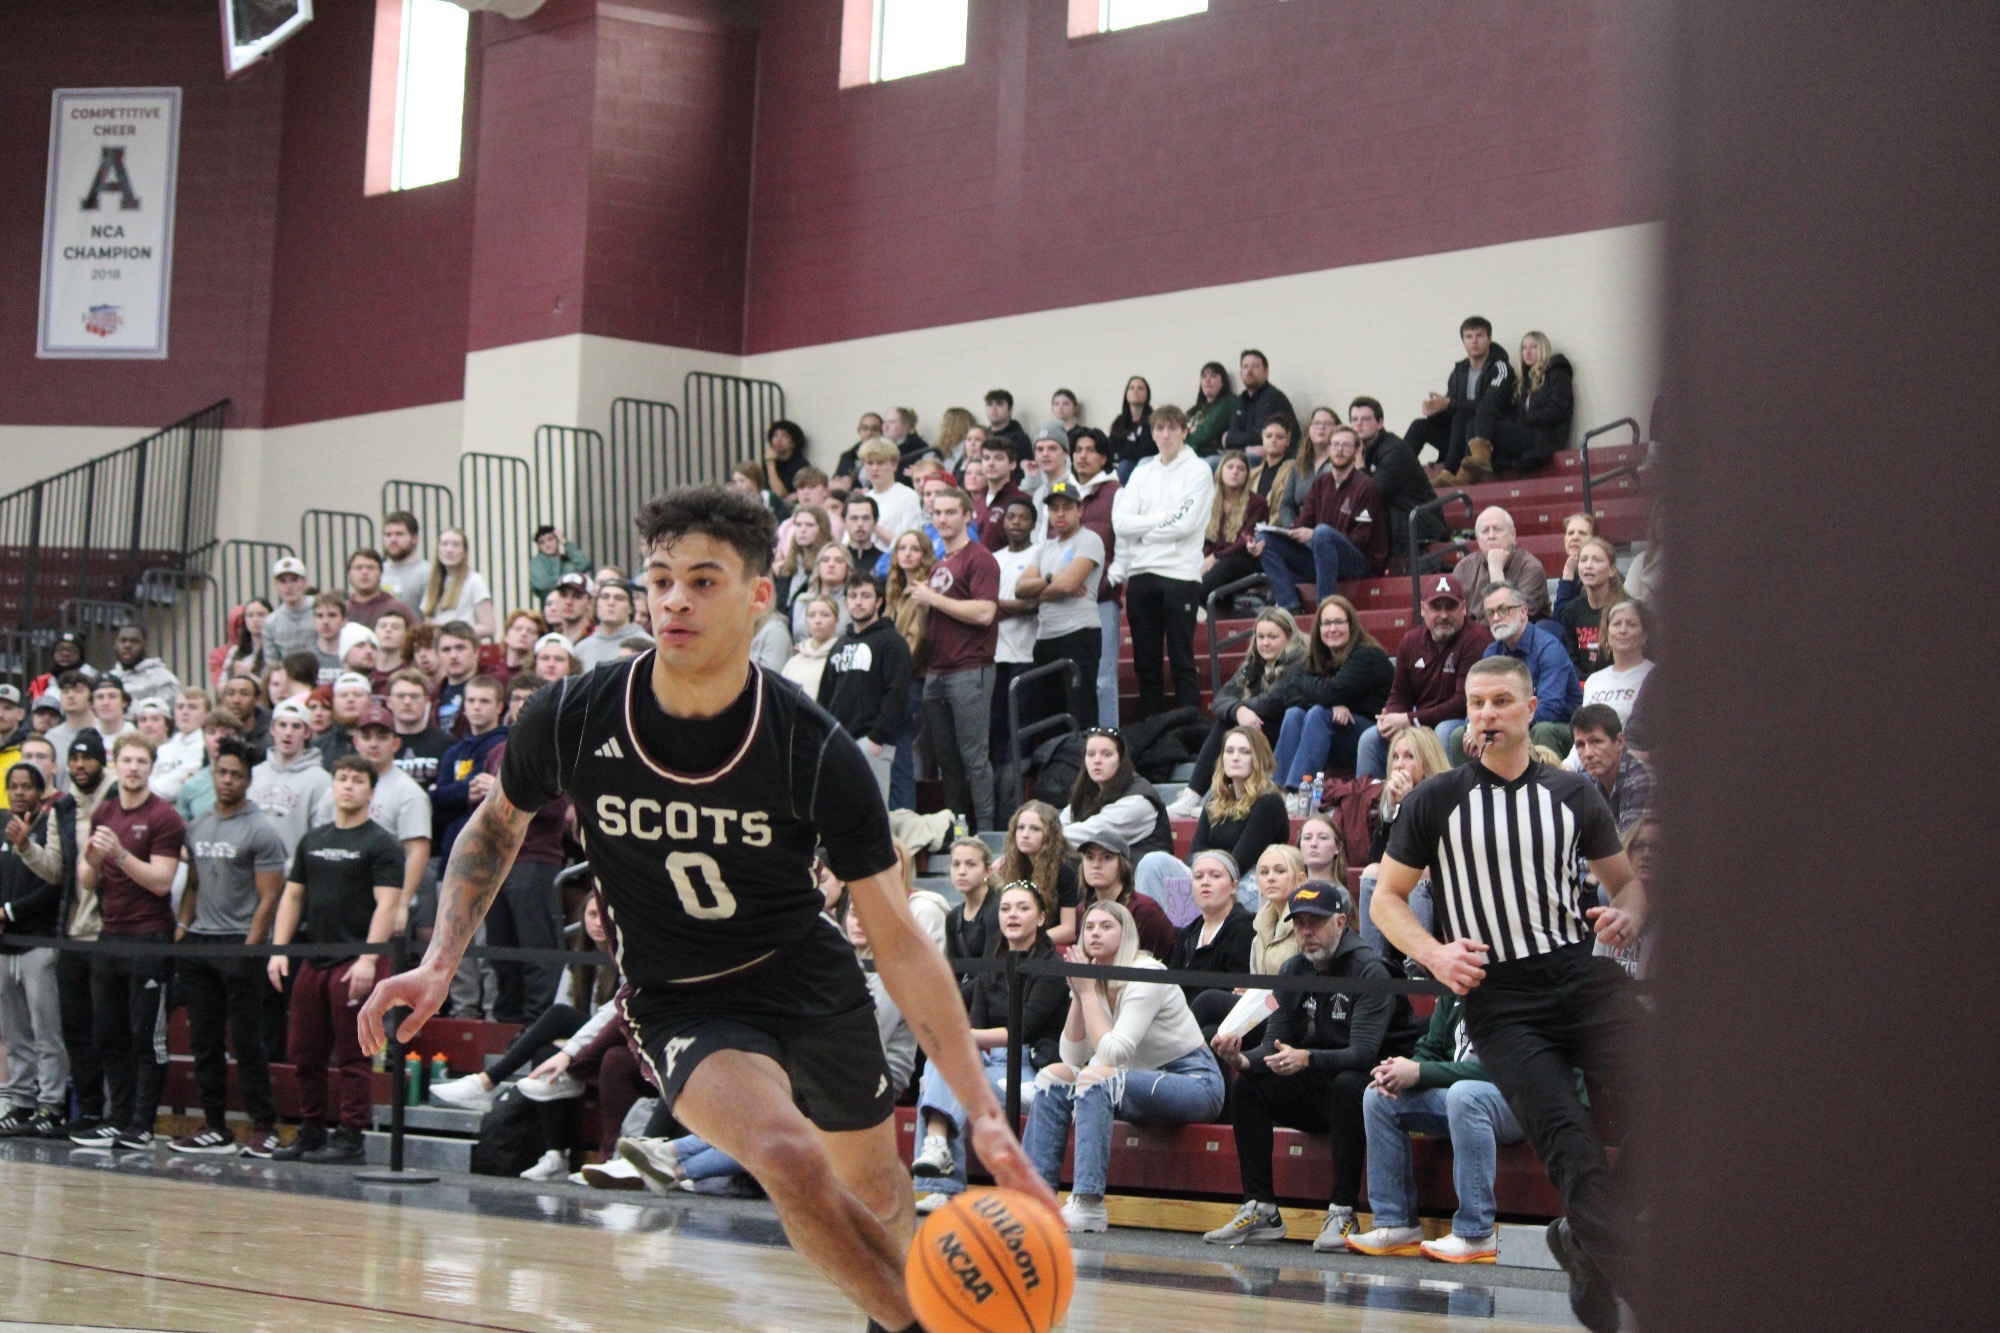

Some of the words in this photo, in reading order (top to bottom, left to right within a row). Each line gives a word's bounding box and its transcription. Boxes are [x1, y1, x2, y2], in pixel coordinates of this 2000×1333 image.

[71, 107, 160, 119] COMPETITIVE
[93, 125, 136, 136] CHEER
[79, 145, 141, 211] A
[90, 225, 125, 238] NCA
[63, 246, 151, 260] CHAMPION
[91, 268, 121, 280] 2018
[1436, 577, 1451, 592] A
[597, 794, 772, 846] SCOTS
[665, 851, 736, 920] 0
[973, 1194, 1040, 1290] Wilson
[937, 1231, 994, 1304] NCAA
